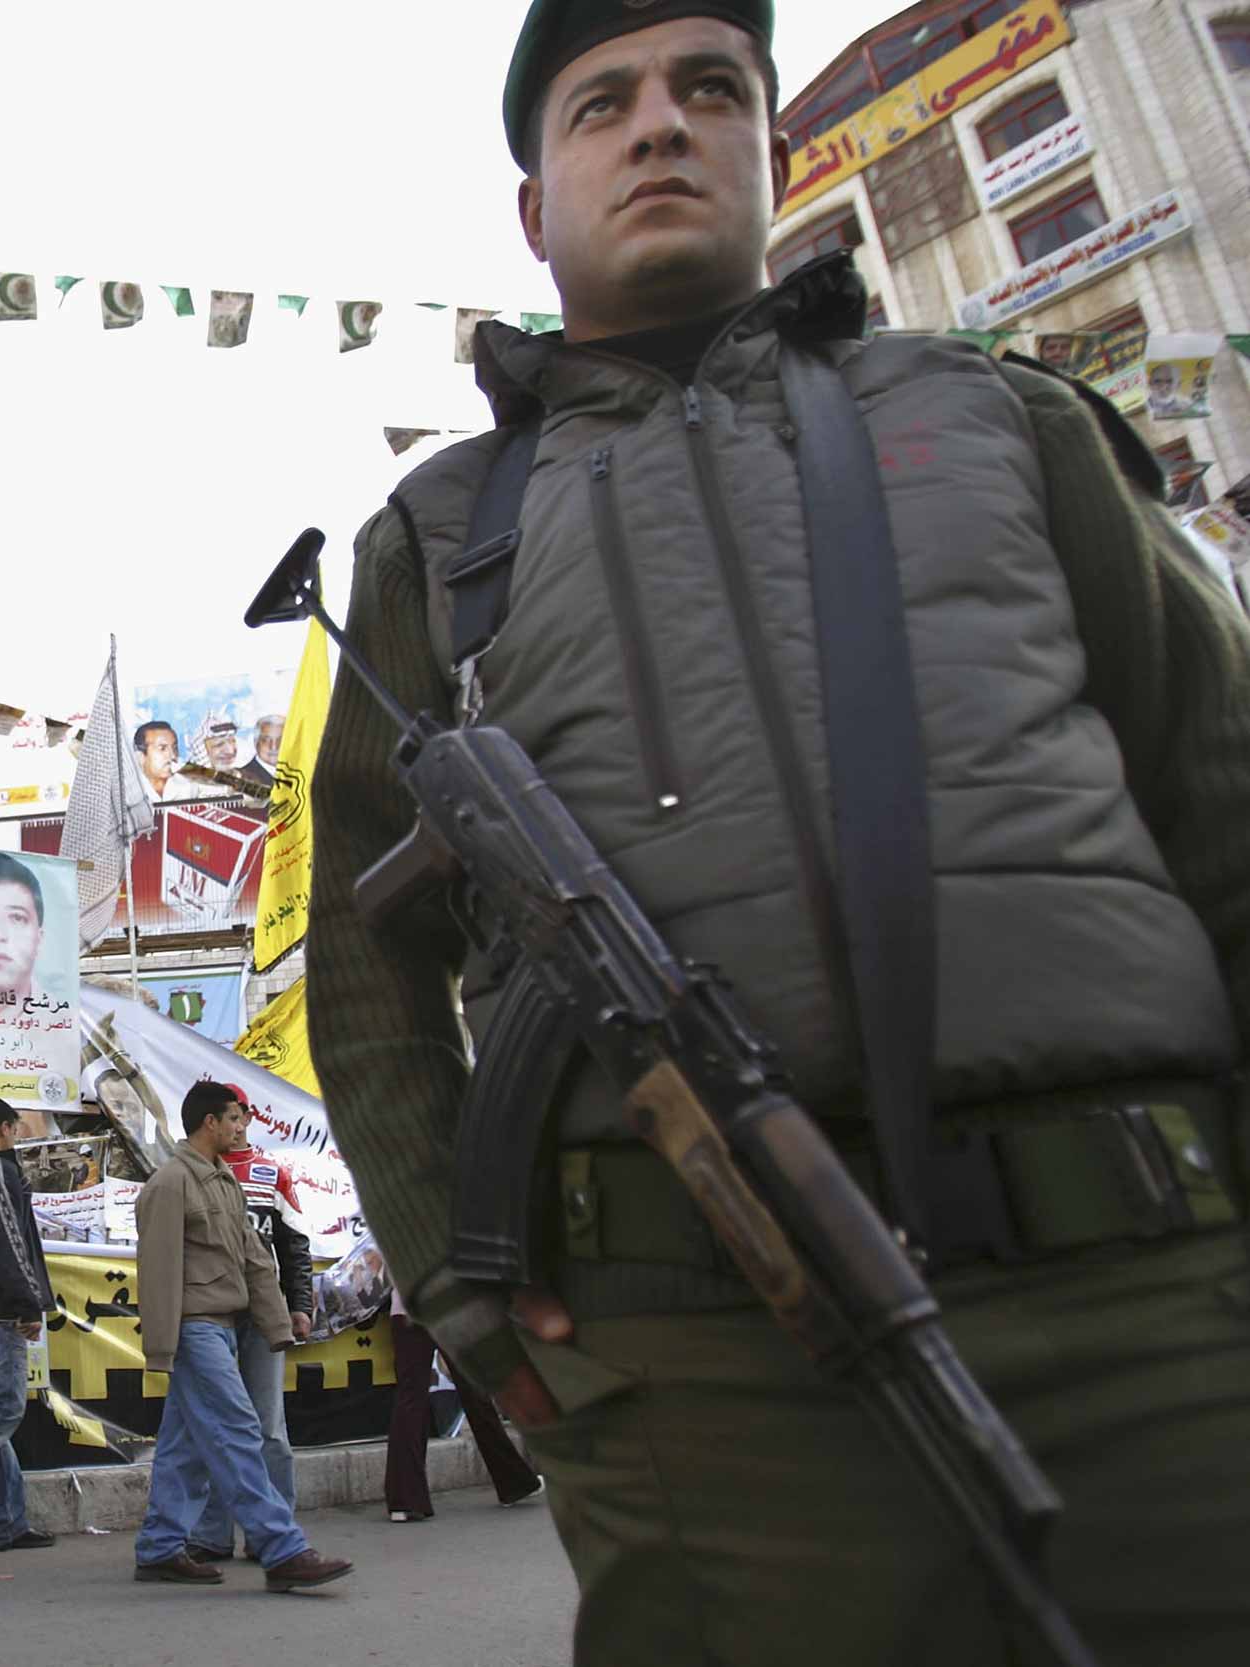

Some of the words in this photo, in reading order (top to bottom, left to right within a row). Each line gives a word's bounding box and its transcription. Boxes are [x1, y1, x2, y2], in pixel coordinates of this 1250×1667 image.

[22, 990, 70, 1014] مرشح
[11, 1016, 40, 1030] داوود
[44, 1019, 72, 1032] ناصر
